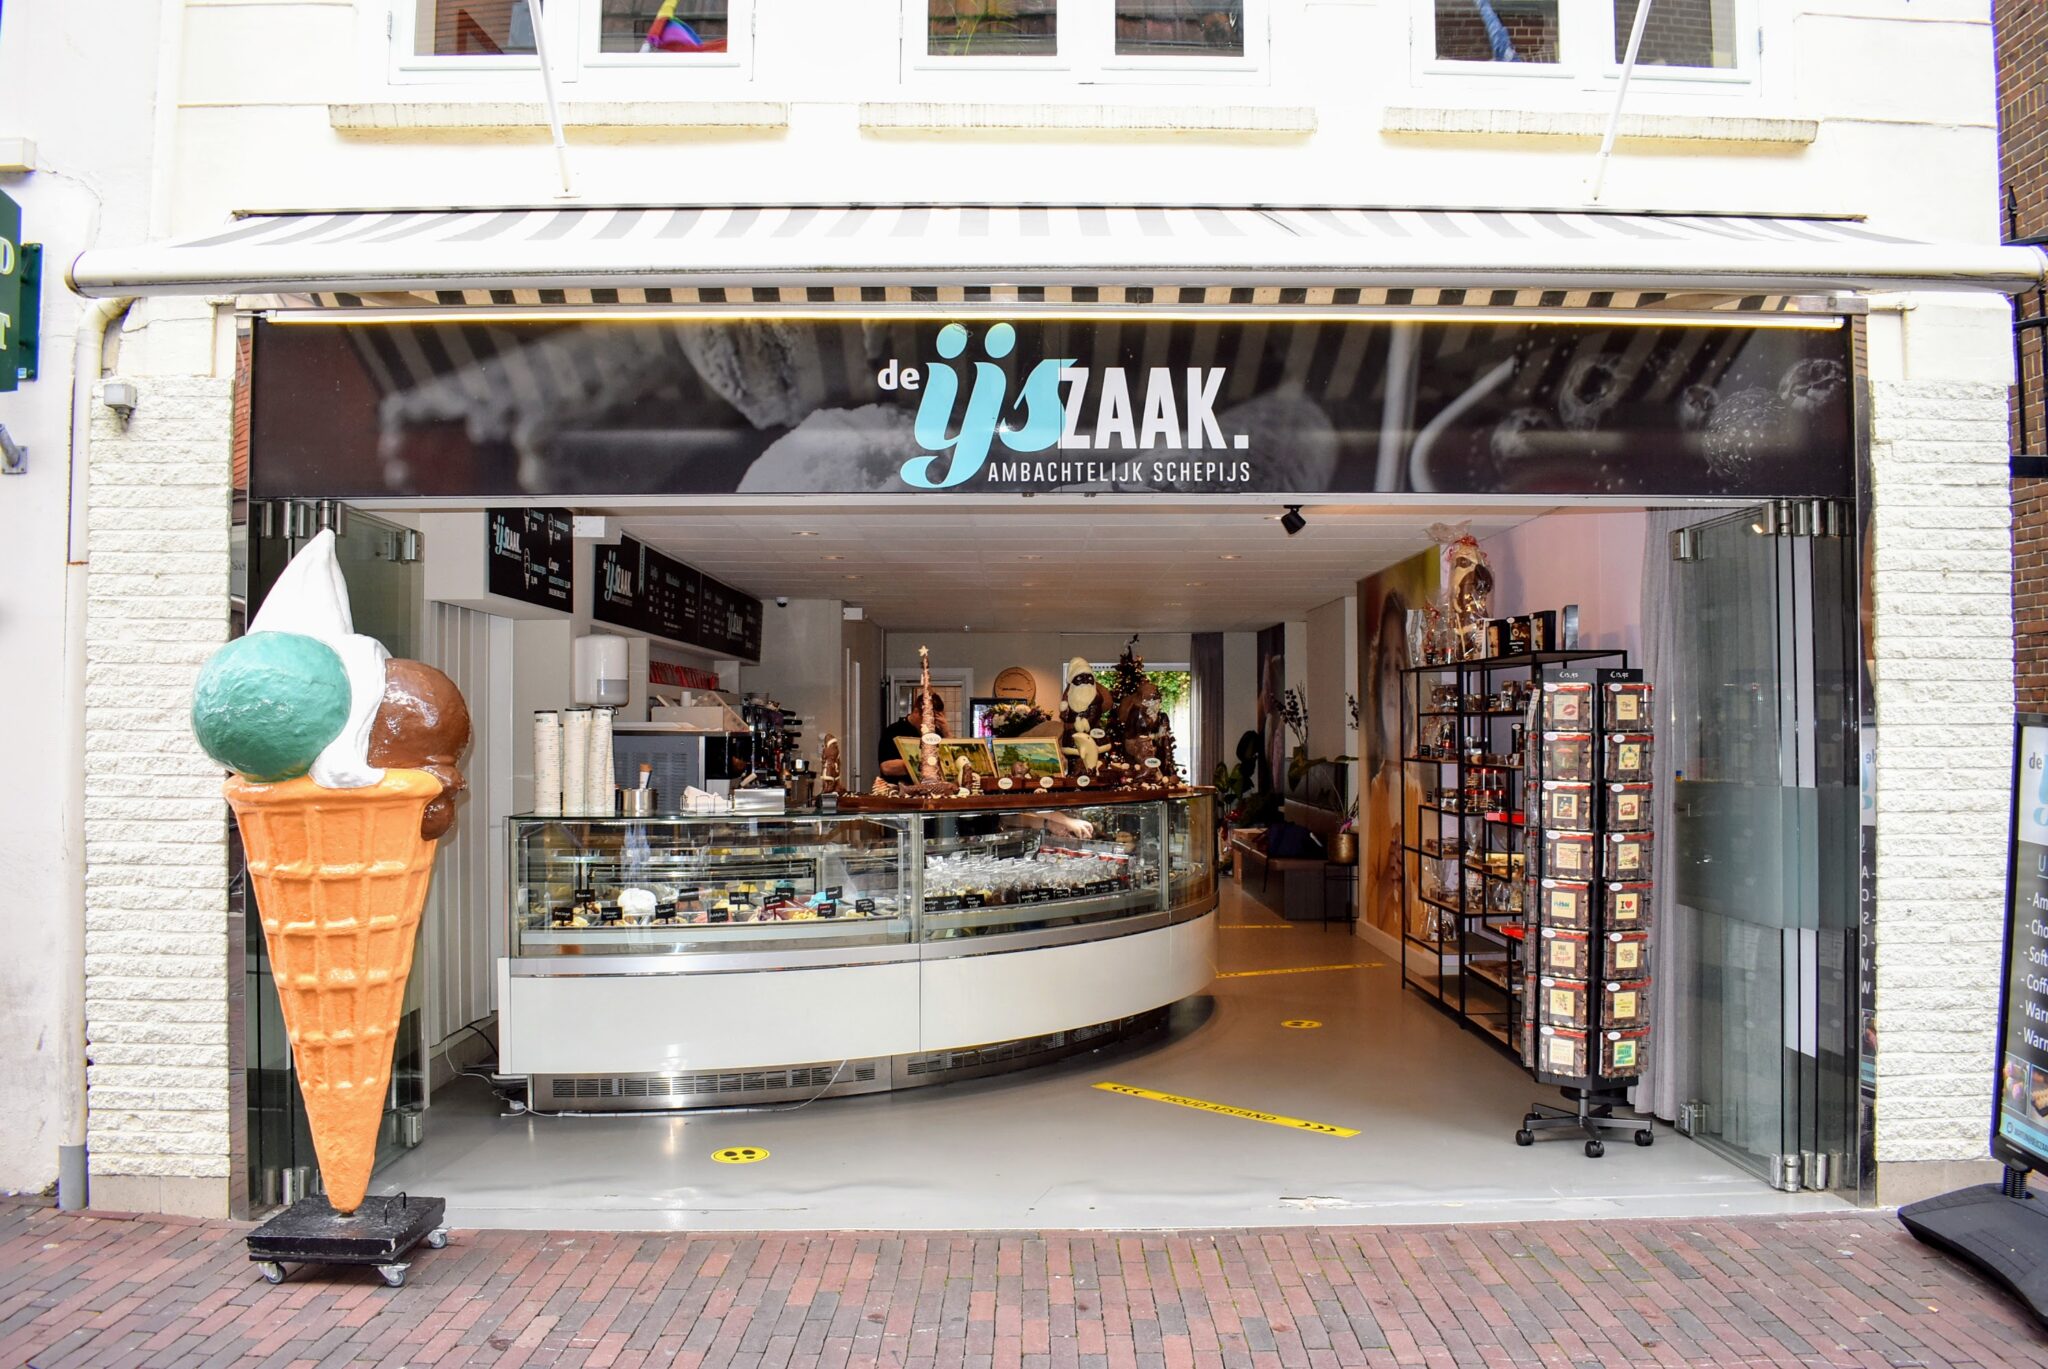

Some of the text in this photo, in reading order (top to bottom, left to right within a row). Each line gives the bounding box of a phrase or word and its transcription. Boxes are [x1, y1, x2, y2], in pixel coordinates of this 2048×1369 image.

[877, 359, 920, 391] de
[988, 461, 1251, 483] AMBACHTELIJK SCHEPIJS
[2028, 751, 2042, 770] de
[1161, 1095, 1277, 1122] HOUD AFSTAND
